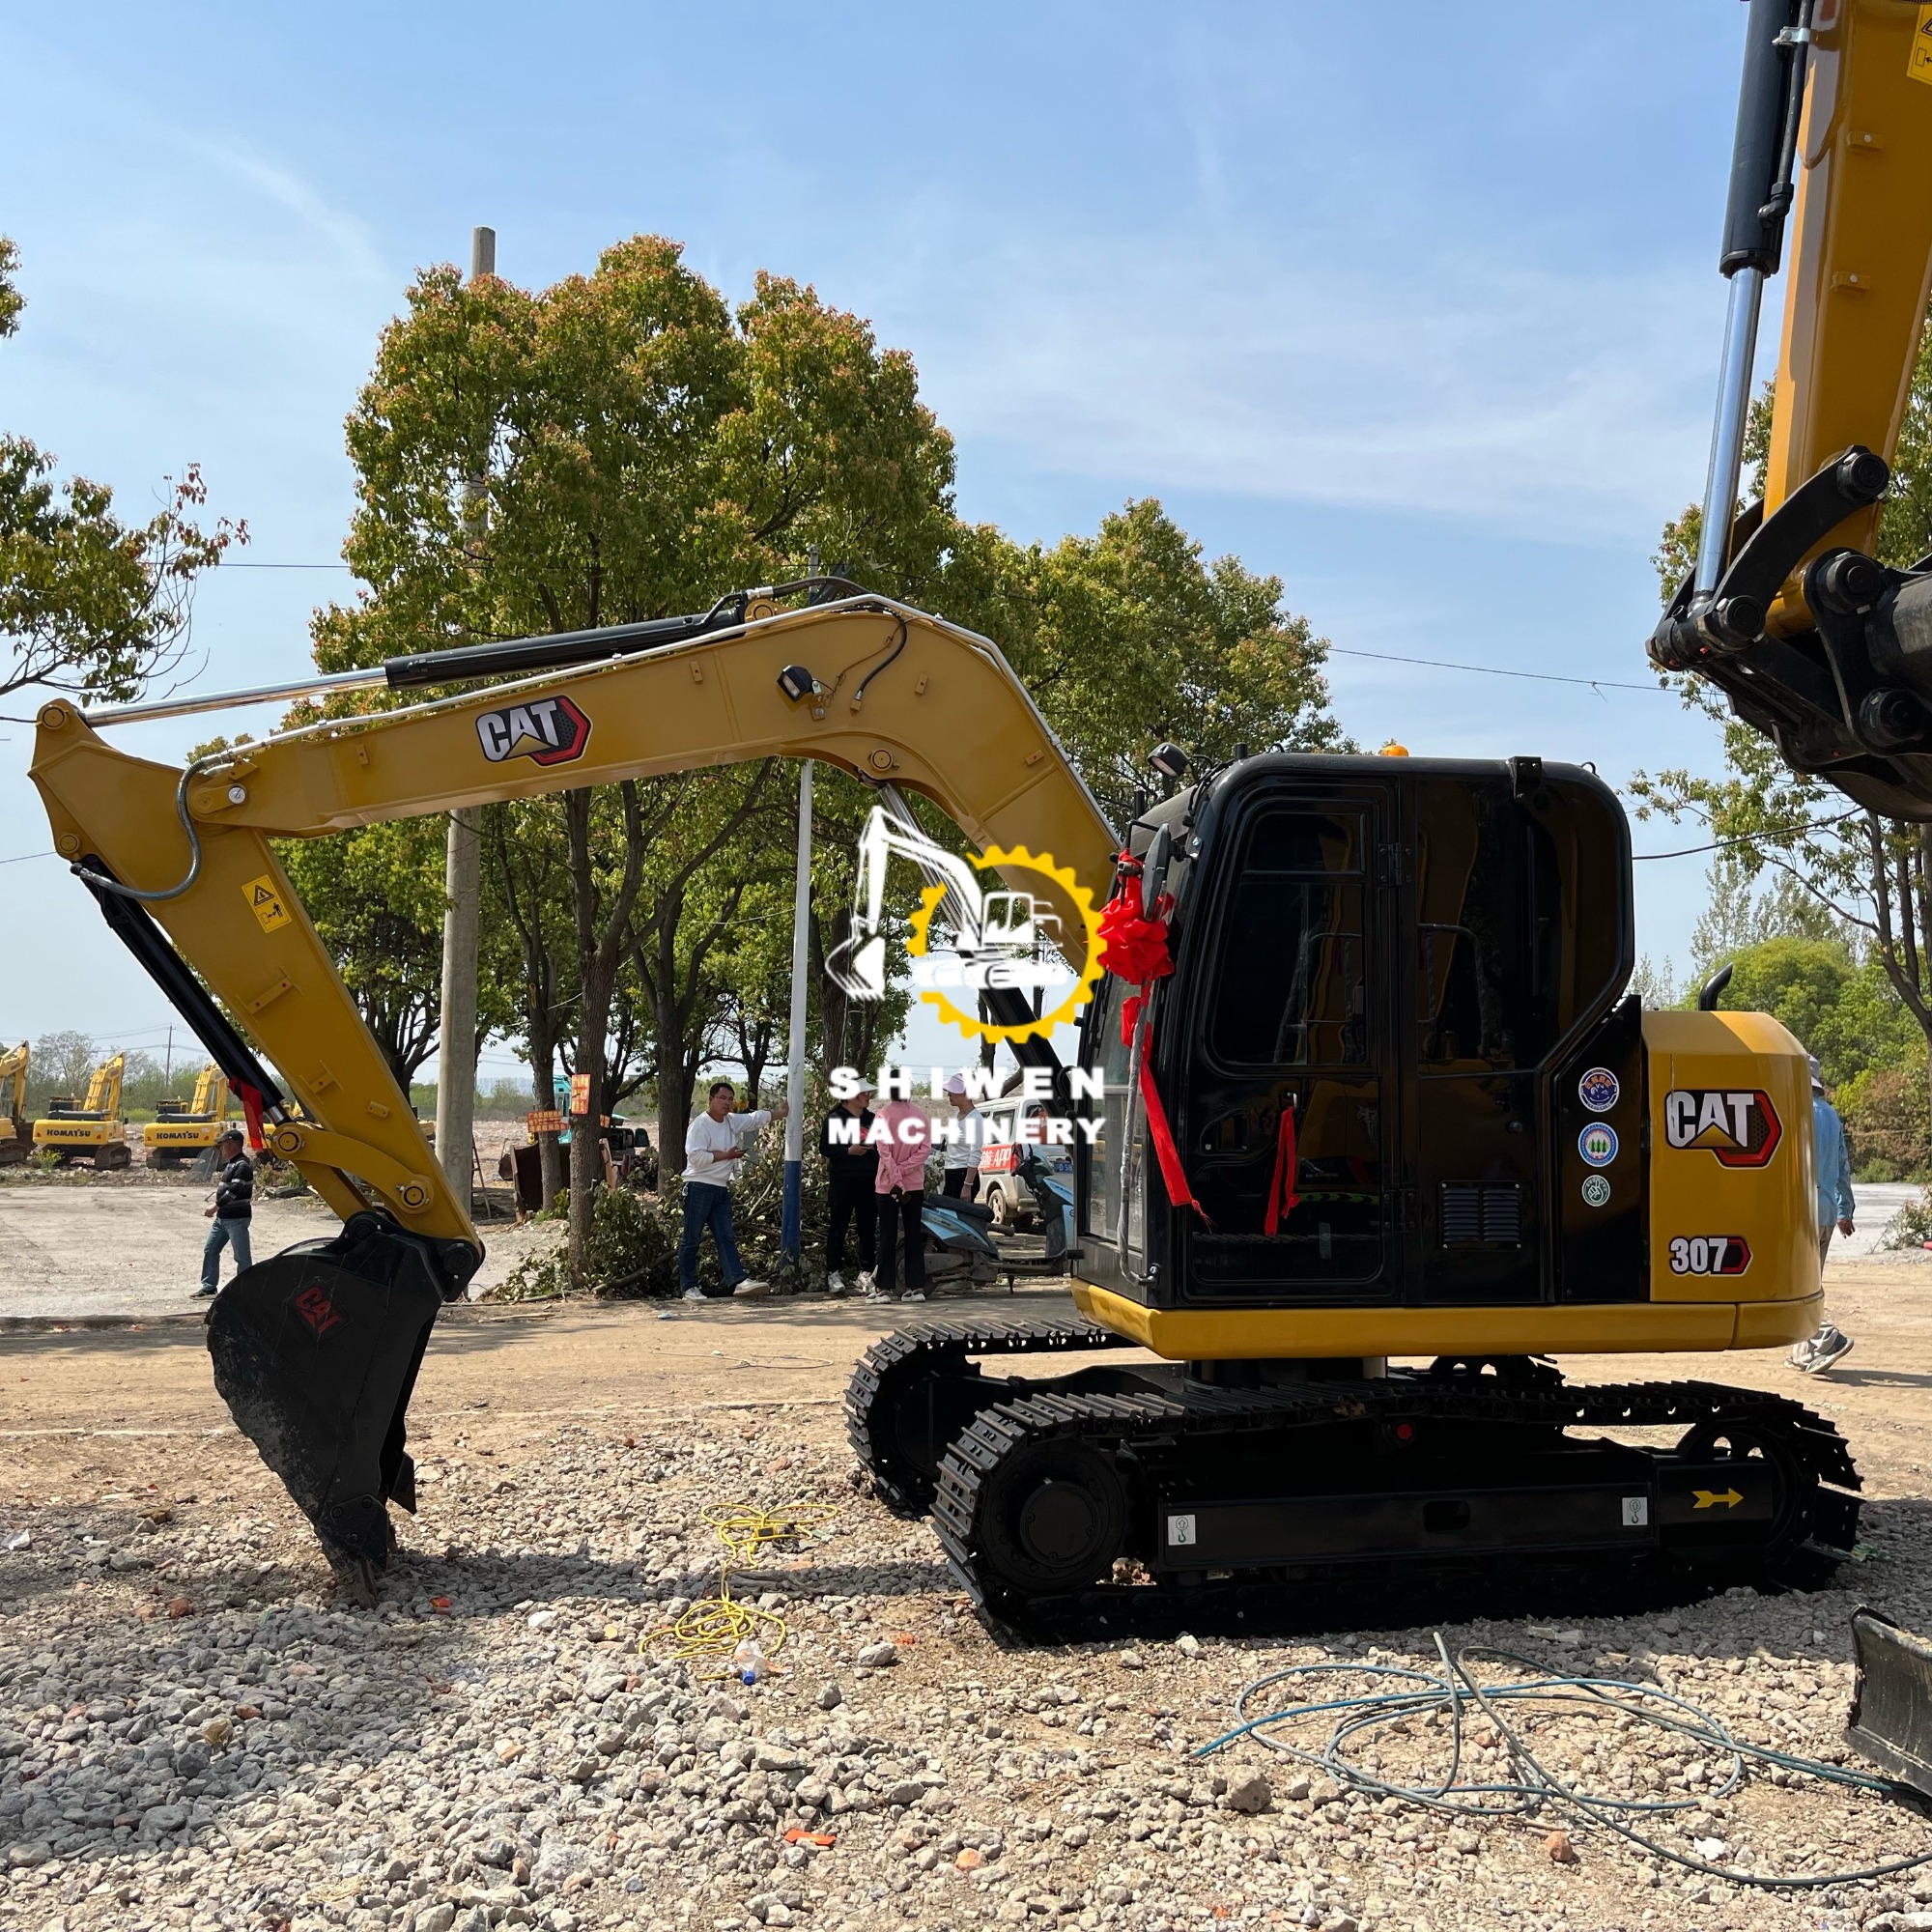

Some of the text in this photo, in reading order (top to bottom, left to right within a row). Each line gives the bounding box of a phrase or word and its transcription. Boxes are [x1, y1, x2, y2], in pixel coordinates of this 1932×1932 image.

[477, 700, 559, 760] CAT
[46, 1128, 91, 1137] KOMATSU
[156, 1130, 199, 1140] KOMATSU
[1666, 1091, 1755, 1148] CAT
[1670, 1237, 1728, 1272] 307
